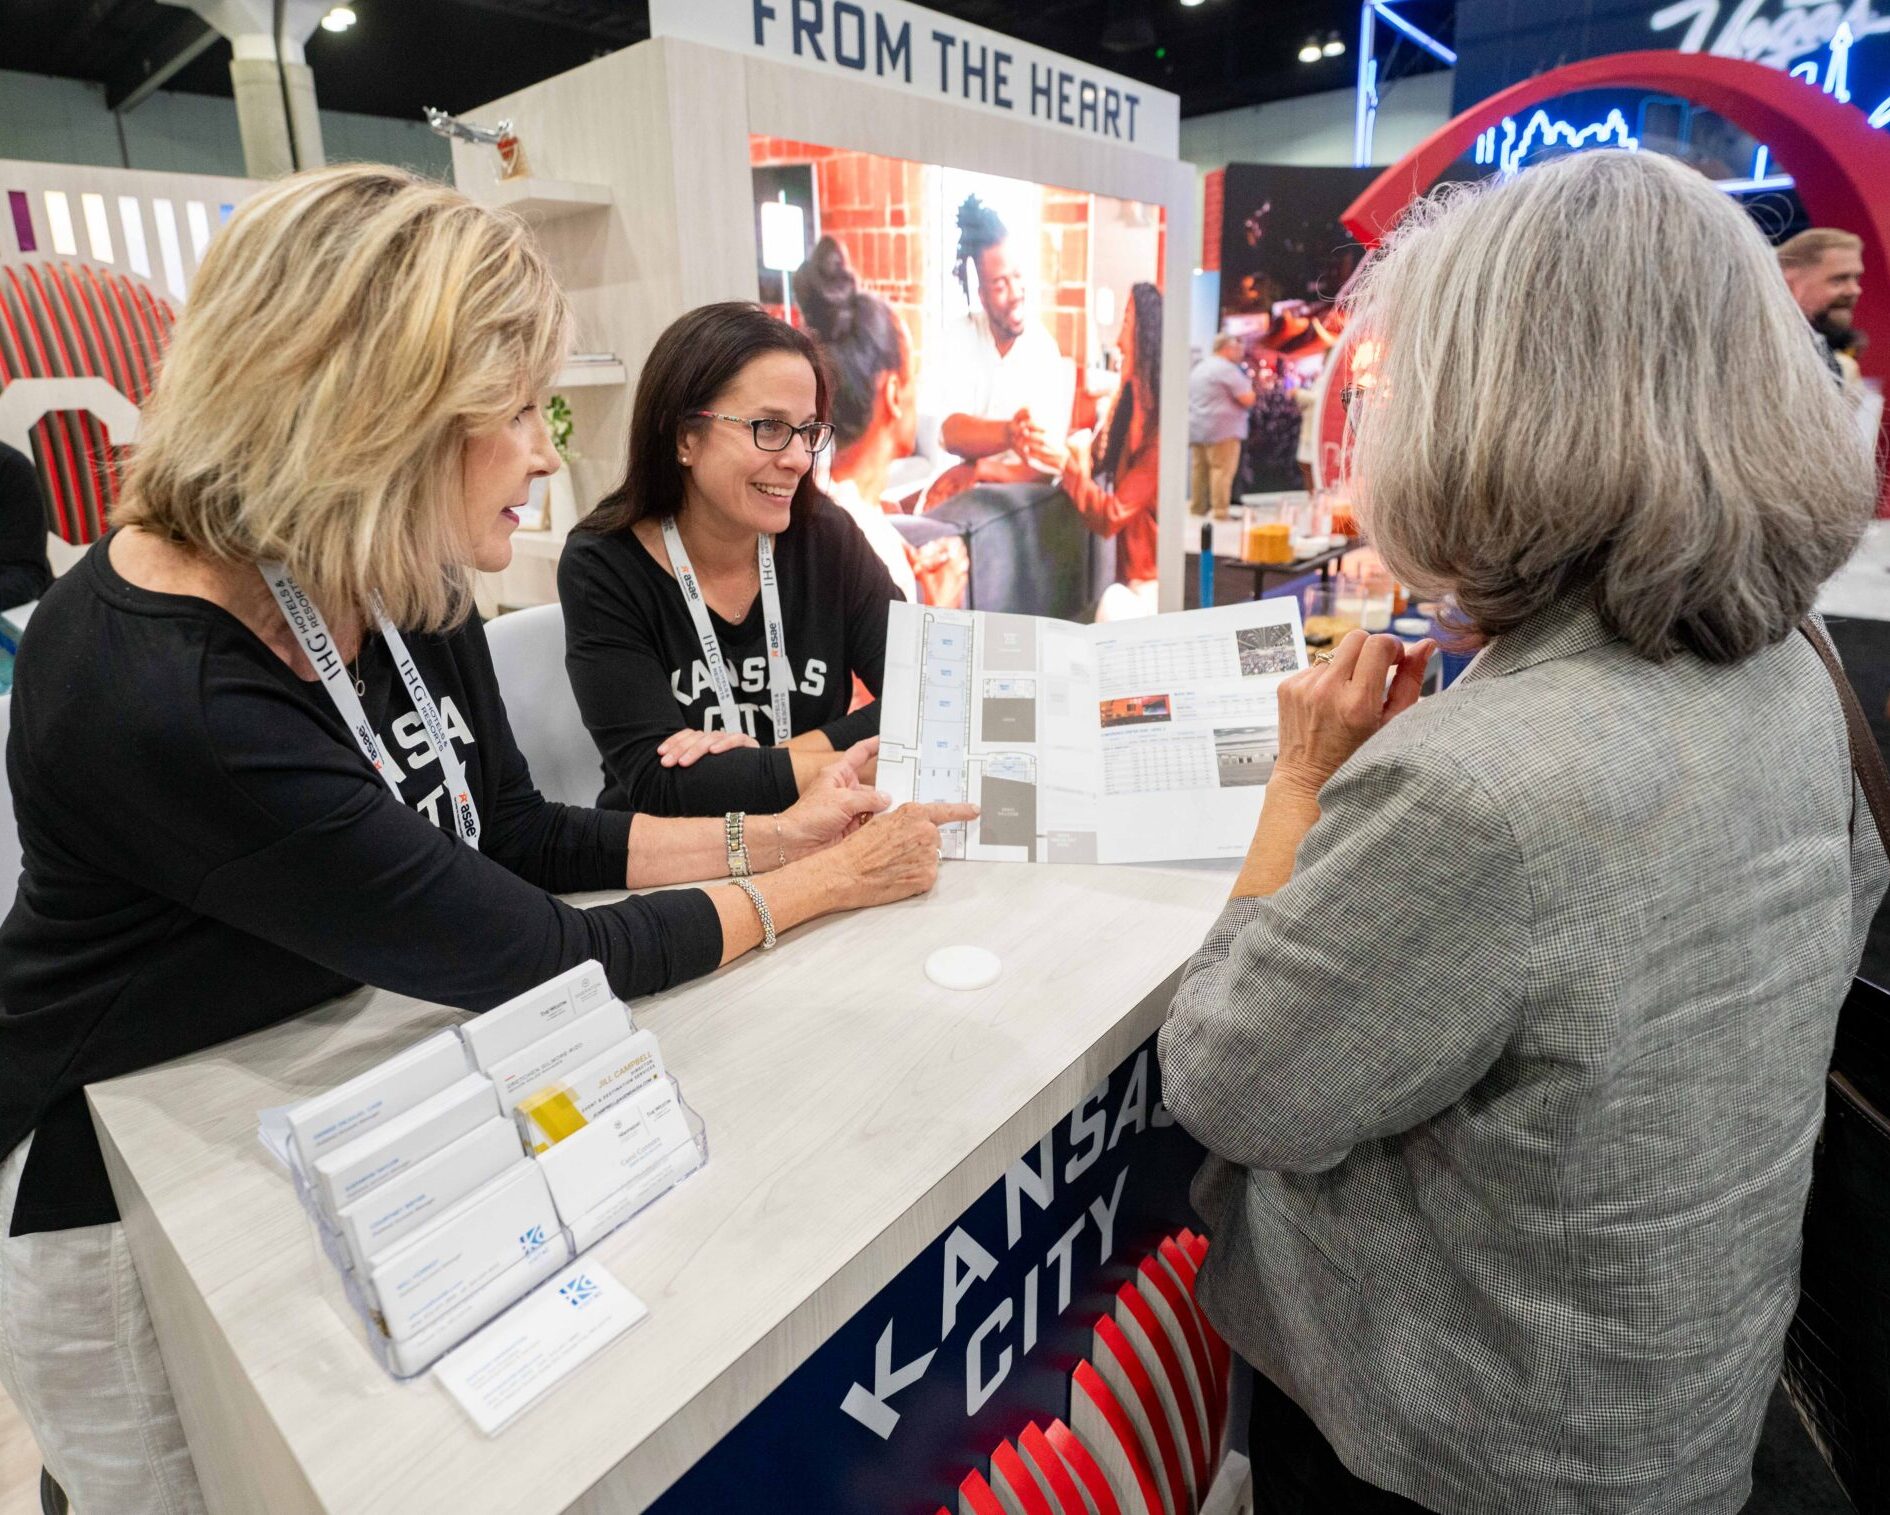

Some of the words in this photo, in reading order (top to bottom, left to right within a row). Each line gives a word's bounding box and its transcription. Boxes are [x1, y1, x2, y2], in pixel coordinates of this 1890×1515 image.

[753, 0, 912, 83] FROM
[932, 30, 1013, 109] THE
[1031, 62, 1140, 143] HEART
[275, 579, 285, 588] &
[683, 574, 699, 600] asae
[280, 589, 309, 634] HOTELS
[306, 632, 341, 681] IHG
[703, 634, 720, 664] IHG
[400, 659, 427, 702] IHG
[421, 706, 444, 752] RESORTS
[426, 702, 446, 740] HOTELS
[358, 725, 378, 761] asae
[460, 804, 477, 837] asae
[612, 1050, 653, 1078] CAMPBELL
[966, 1165, 1129, 1417] CITY
